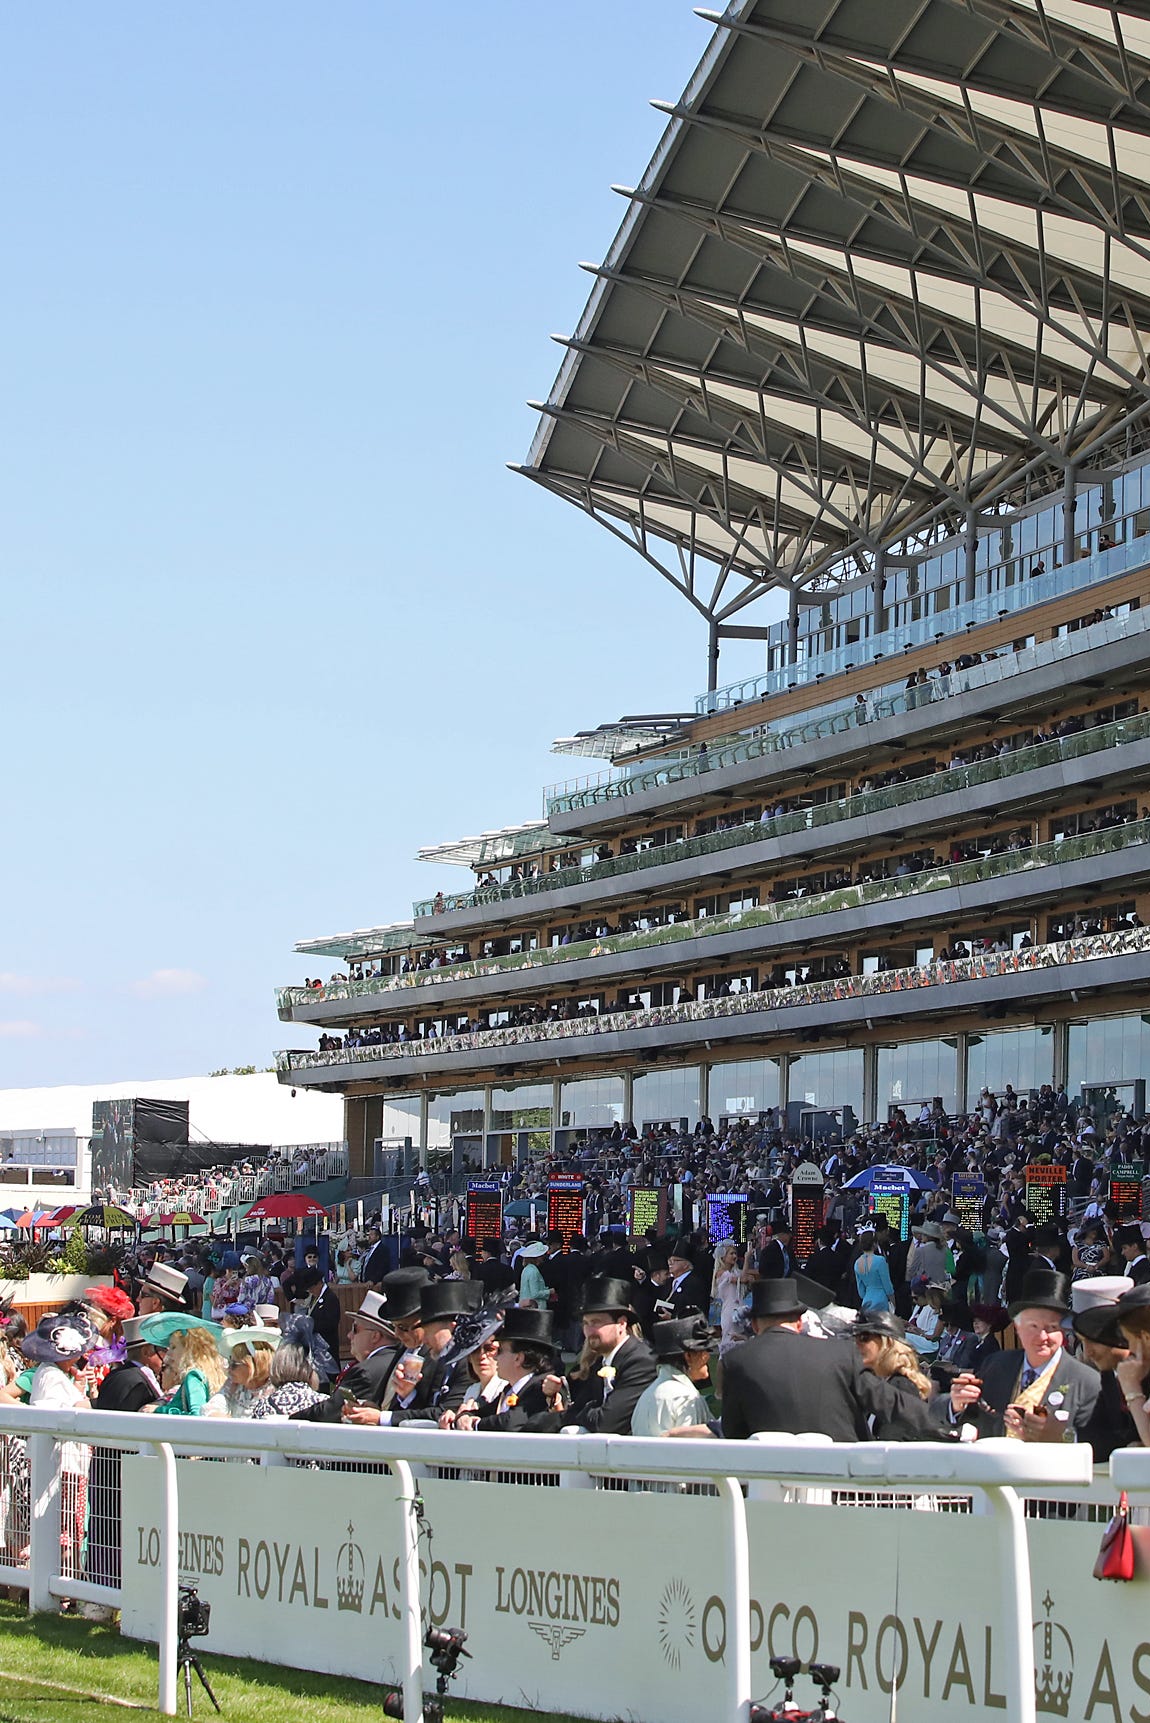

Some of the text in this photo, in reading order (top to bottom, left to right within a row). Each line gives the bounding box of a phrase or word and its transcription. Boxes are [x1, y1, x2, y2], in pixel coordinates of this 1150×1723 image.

[138, 1527, 224, 1577] LOINES
[237, 1538, 329, 1609] ROYAL
[495, 1566, 620, 1628] LONGINES
[702, 1595, 819, 1675] QPCO
[846, 1611, 1007, 1710] ROYAL
